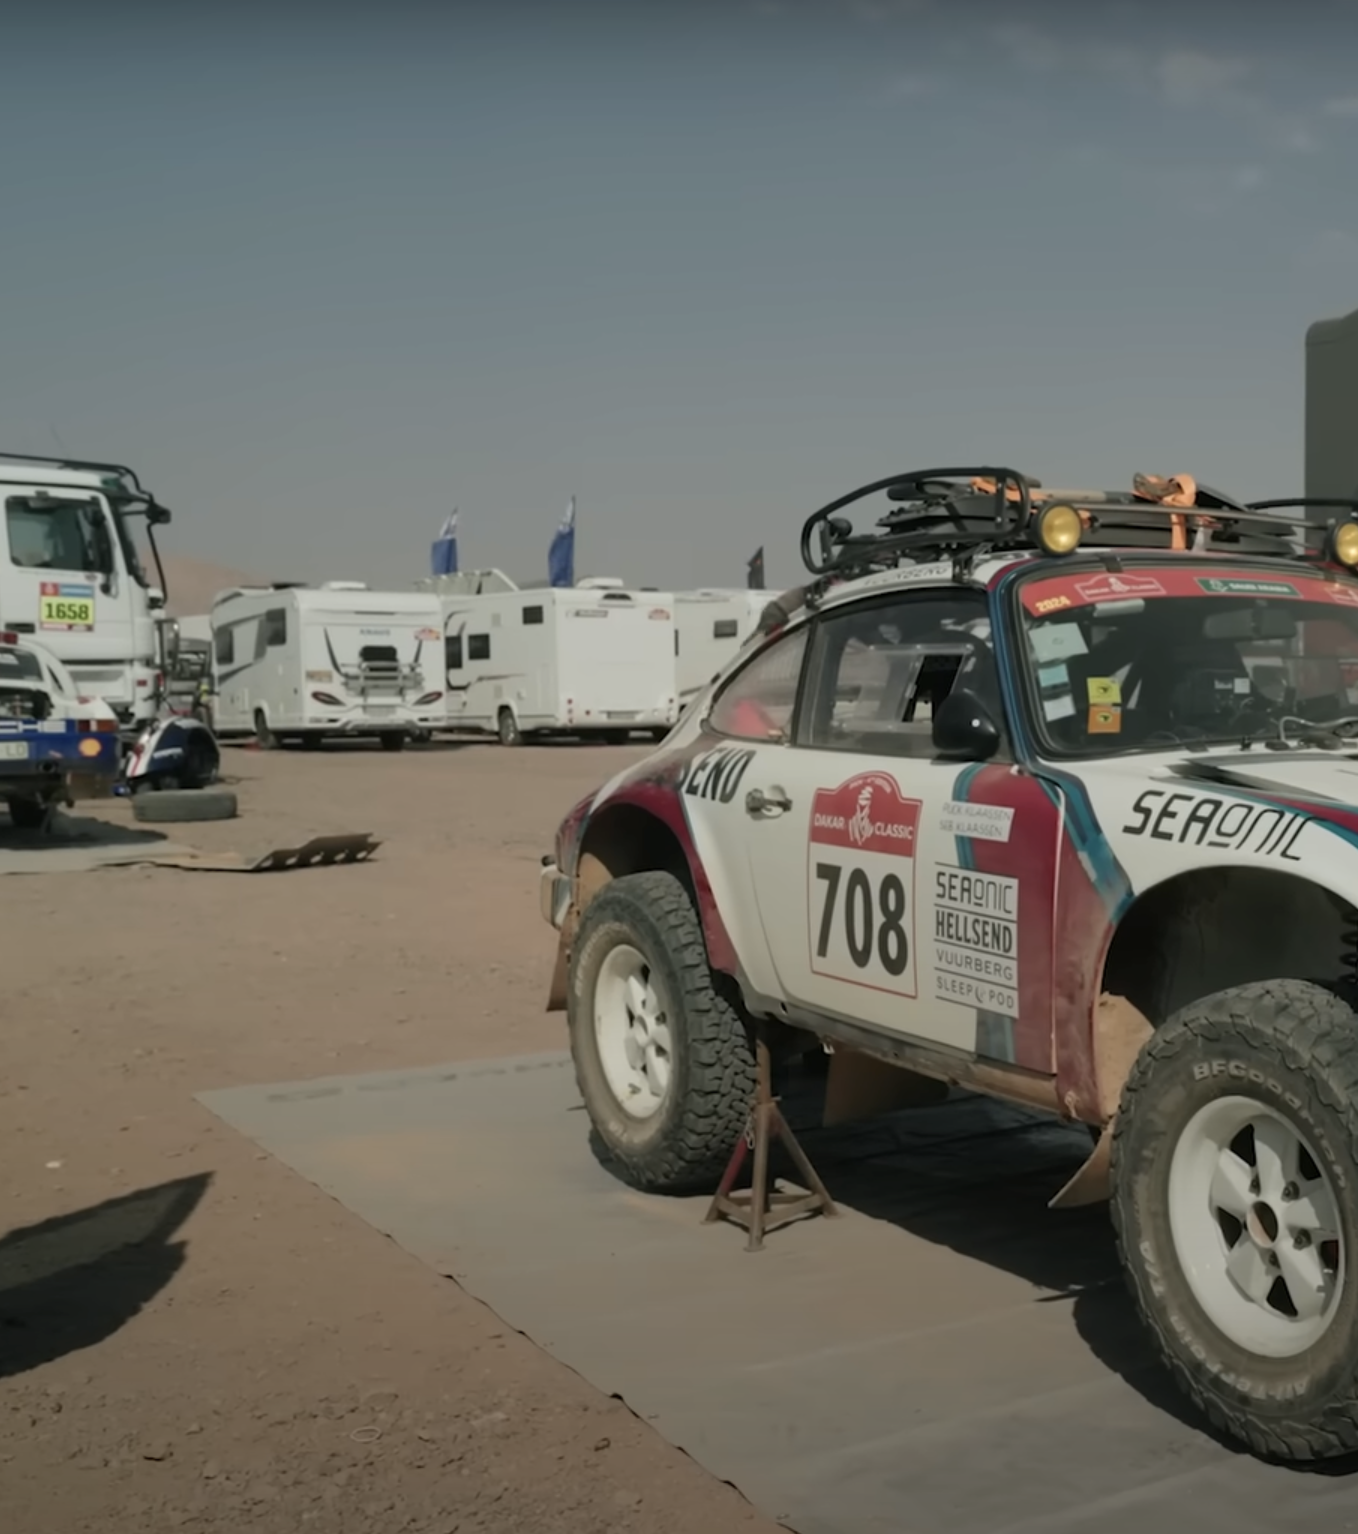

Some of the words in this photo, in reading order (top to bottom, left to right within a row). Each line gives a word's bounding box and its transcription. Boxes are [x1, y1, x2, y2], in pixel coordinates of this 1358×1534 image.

[45, 602, 89, 622] 1658
[1035, 595, 1071, 612] 2024
[814, 813, 845, 830] DAKAR
[875, 822, 913, 840] CLASSIC
[1122, 789, 1329, 861] SEAONIC
[936, 871, 1013, 914] SEAONIC
[816, 861, 908, 976] 708
[935, 910, 1013, 954] HELLSEND
[935, 948, 1013, 982] VUURBERG
[936, 975, 974, 998] SLEEP
[988, 989, 1015, 1010] POD
